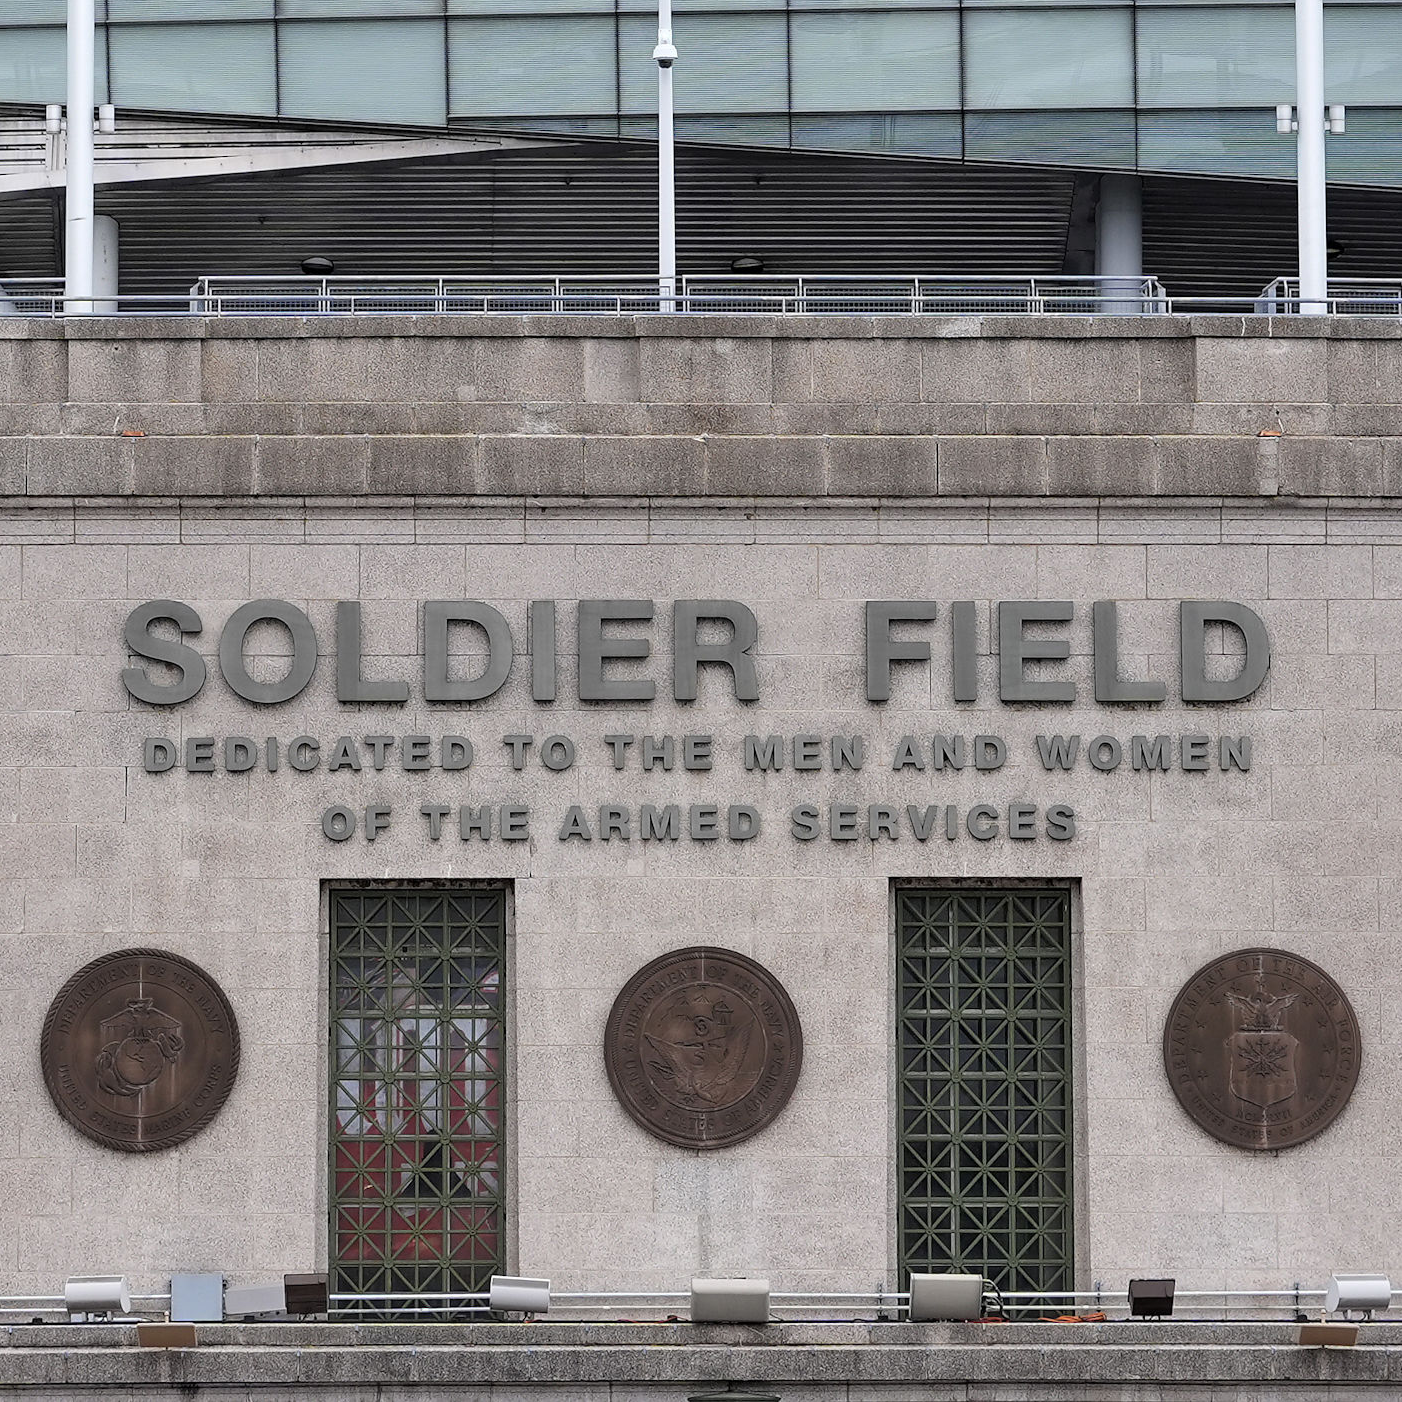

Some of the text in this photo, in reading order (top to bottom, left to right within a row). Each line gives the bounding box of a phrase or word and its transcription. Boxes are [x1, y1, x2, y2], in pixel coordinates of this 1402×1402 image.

[122, 599, 1271, 704] SOLDIER FIELD
[143, 734, 1252, 773] DEDICATED TO THE MEN AND WOMEN
[321, 803, 1077, 842] OF THE ARMED SERVICES
